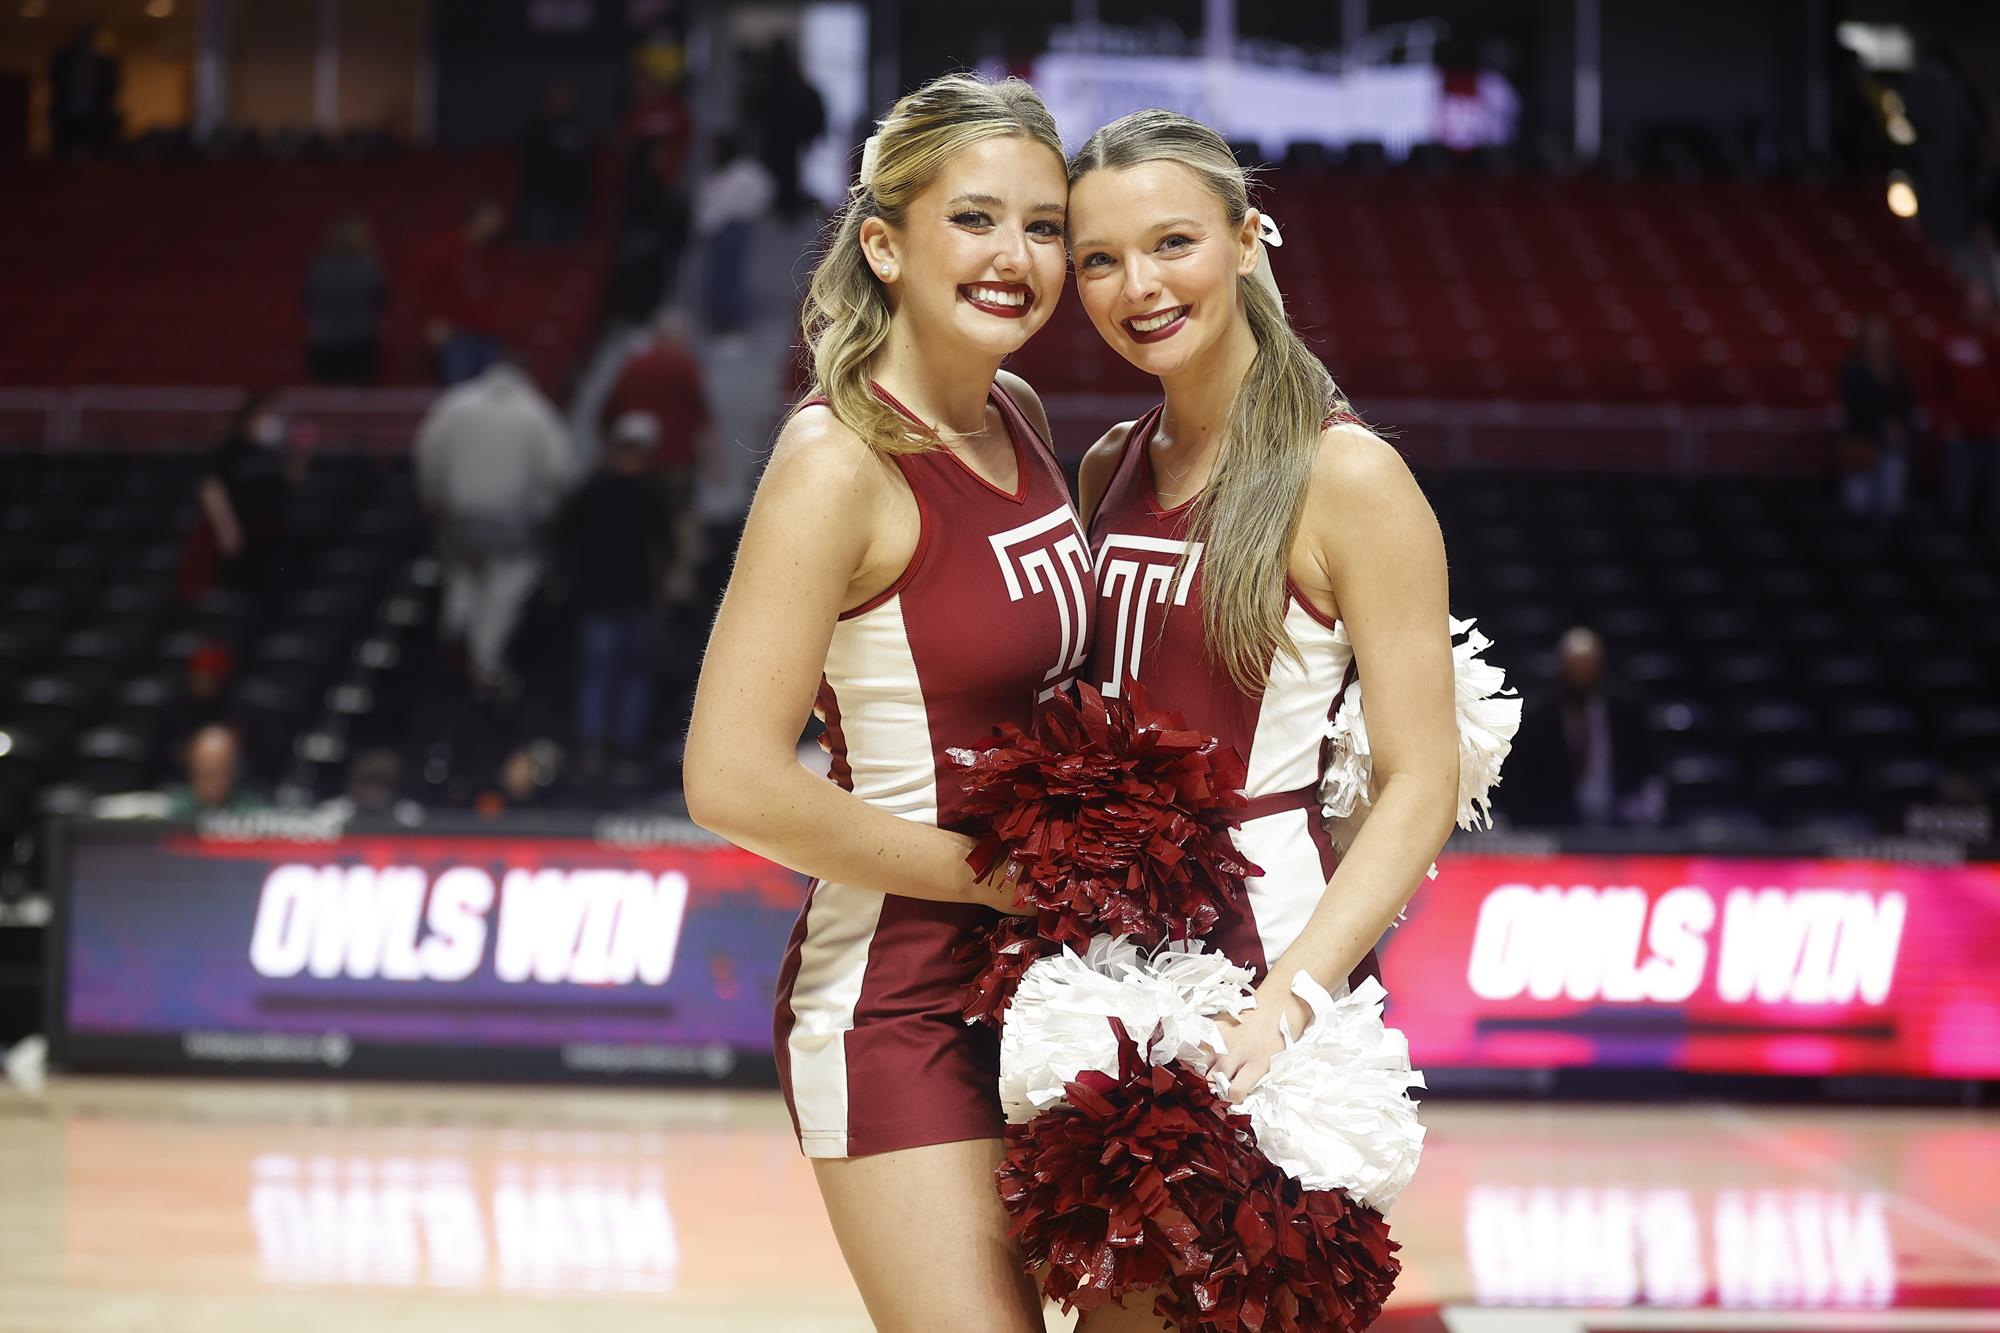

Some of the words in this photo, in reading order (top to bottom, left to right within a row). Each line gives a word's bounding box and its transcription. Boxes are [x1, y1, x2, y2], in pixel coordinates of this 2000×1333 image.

[987, 503, 1095, 705] T
[1093, 533, 1205, 700] T
[250, 864, 496, 981] OWLS
[495, 869, 689, 985] WIN
[1467, 885, 1715, 1001] OWLS
[1716, 889, 1906, 1004] WIN
